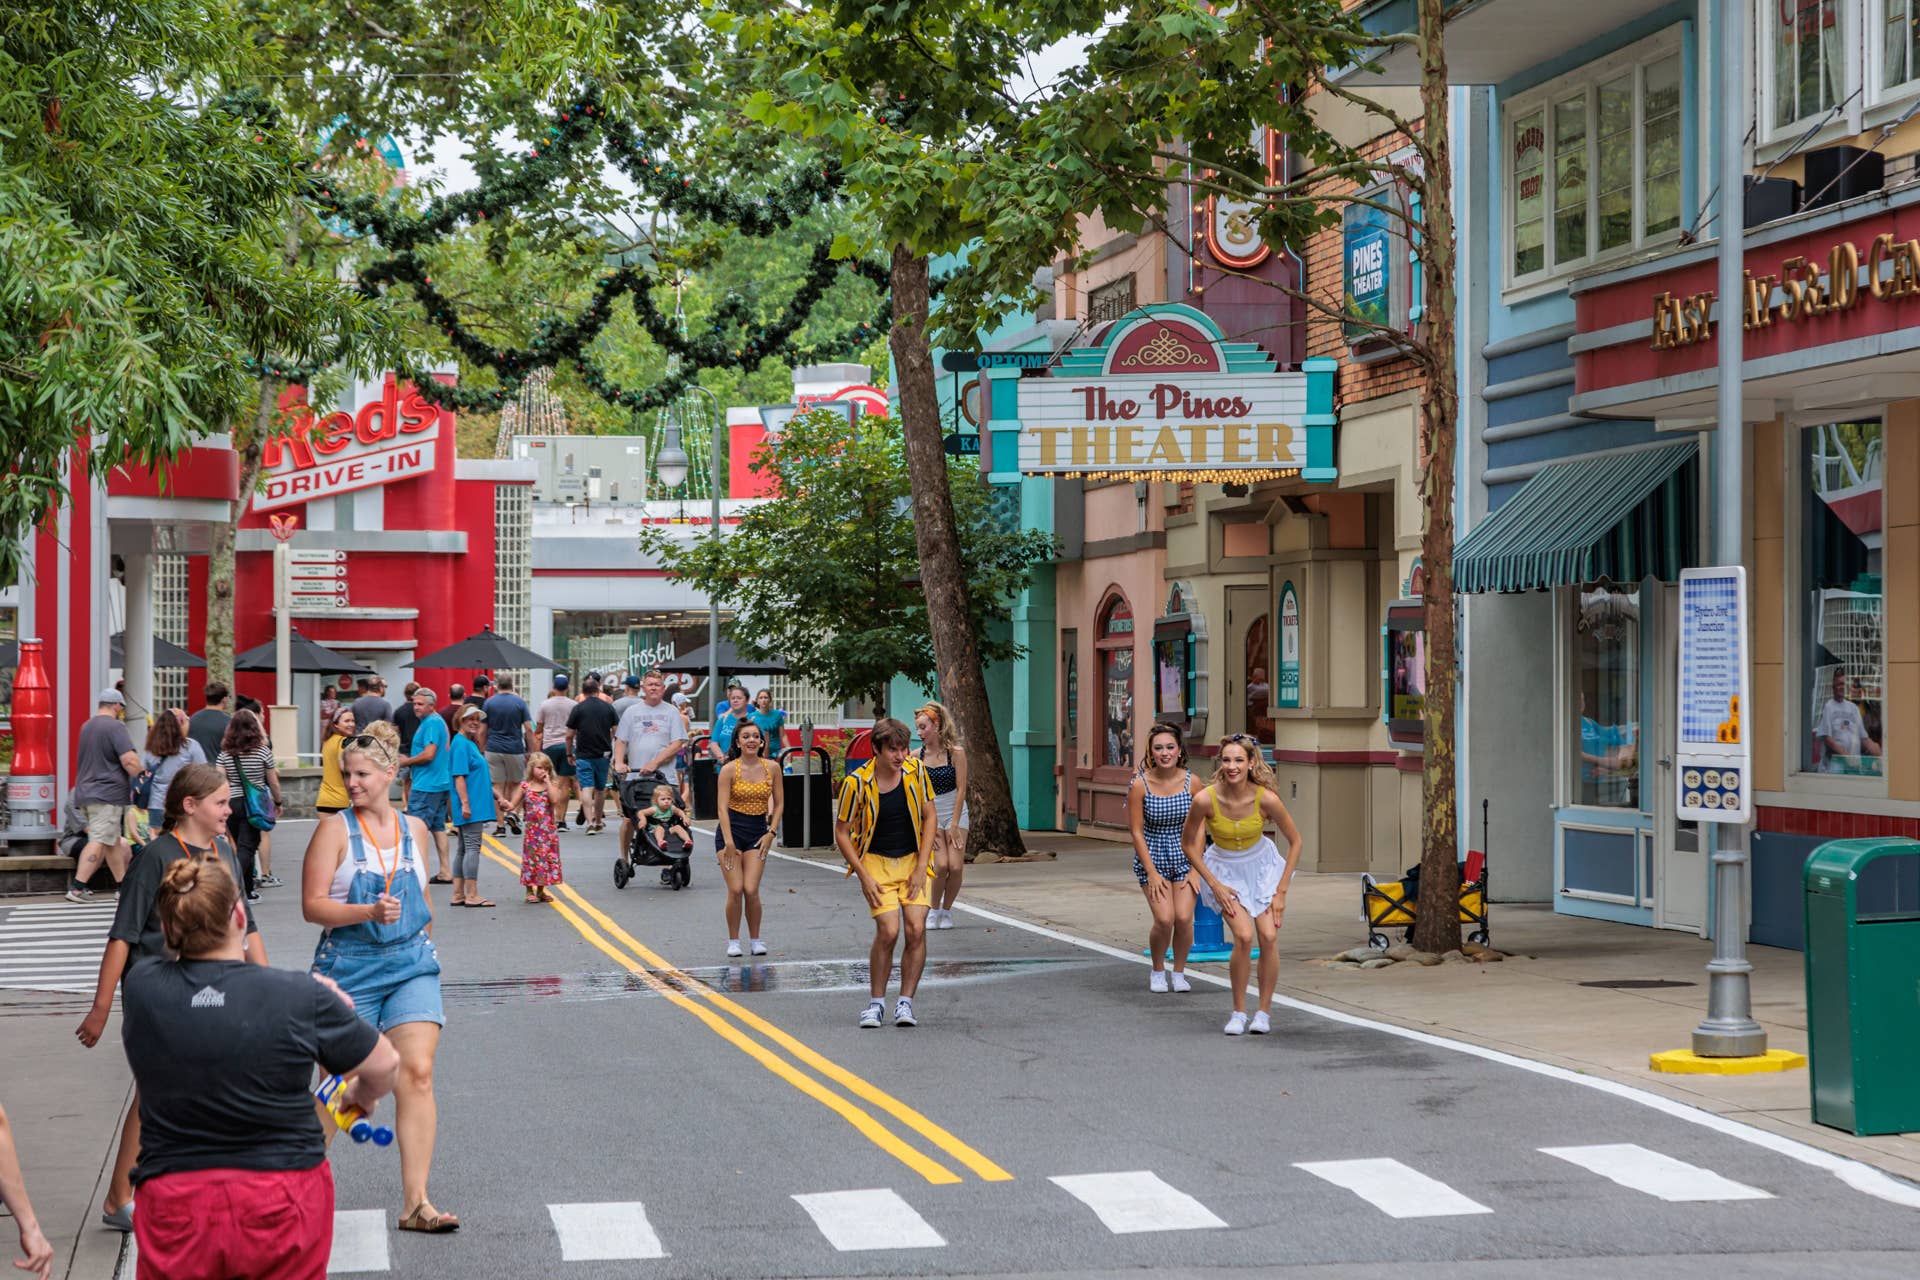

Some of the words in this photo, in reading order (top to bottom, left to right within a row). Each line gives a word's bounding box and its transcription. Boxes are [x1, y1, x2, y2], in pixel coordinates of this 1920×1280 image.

[1353, 240, 1383, 278] PINES
[1353, 270, 1383, 297] THEATER
[1071, 385, 1141, 421] The
[1149, 383, 1253, 420] Pines
[1028, 423, 1296, 466] THEATER
[266, 448, 421, 501] DRIVE-IN
[628, 641, 675, 676] frosty
